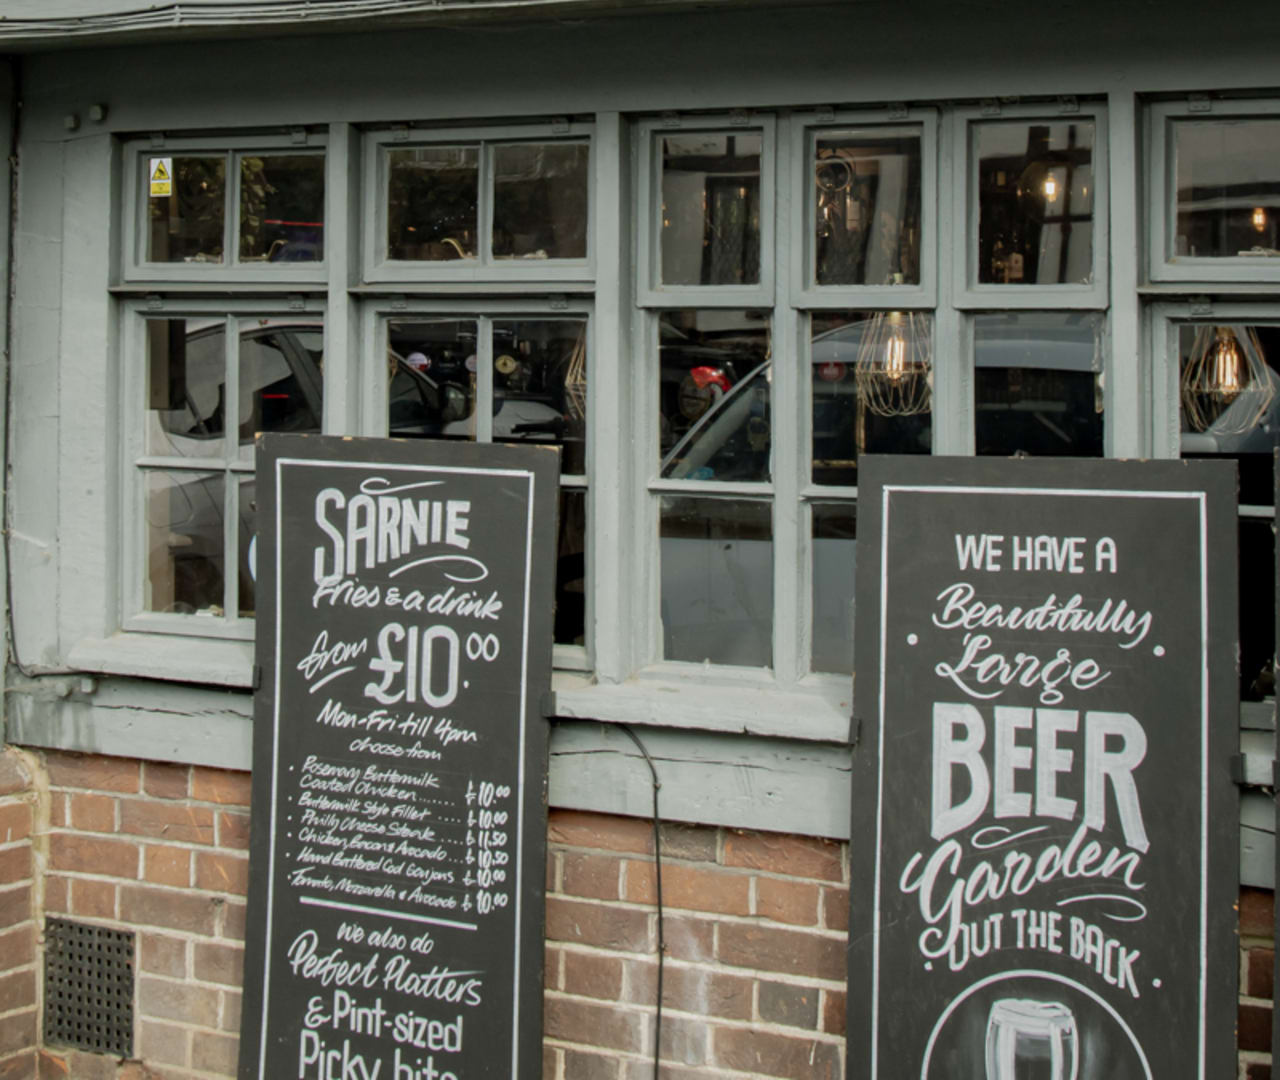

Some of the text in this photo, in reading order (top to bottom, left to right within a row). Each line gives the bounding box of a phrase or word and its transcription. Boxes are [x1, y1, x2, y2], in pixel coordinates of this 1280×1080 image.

[313, 487, 472, 587] SARNIE
[955, 533, 1118, 573] WE HAVE A
[312, 576, 503, 620] Fries & a drink
[932, 582, 1153, 649] Beautifully
[297, 630, 367, 680] from
[935, 633, 1112, 705] Large
[316, 698, 477, 747] Mon-Fri till 4pm
[349, 737, 404, 756] choose
[930, 701, 1151, 855] BEER
[899, 820, 1146, 958] Garden
[287, 929, 485, 1006] Perfect Platters
[367, 927, 406, 950] also
[410, 932, 434, 954] do
[1011, 909, 1063, 953] THE
[1070, 916, 1141, 998] BACK
[304, 989, 463, 1052] & Pint-sized
[394, 1047, 458, 1080] bit
